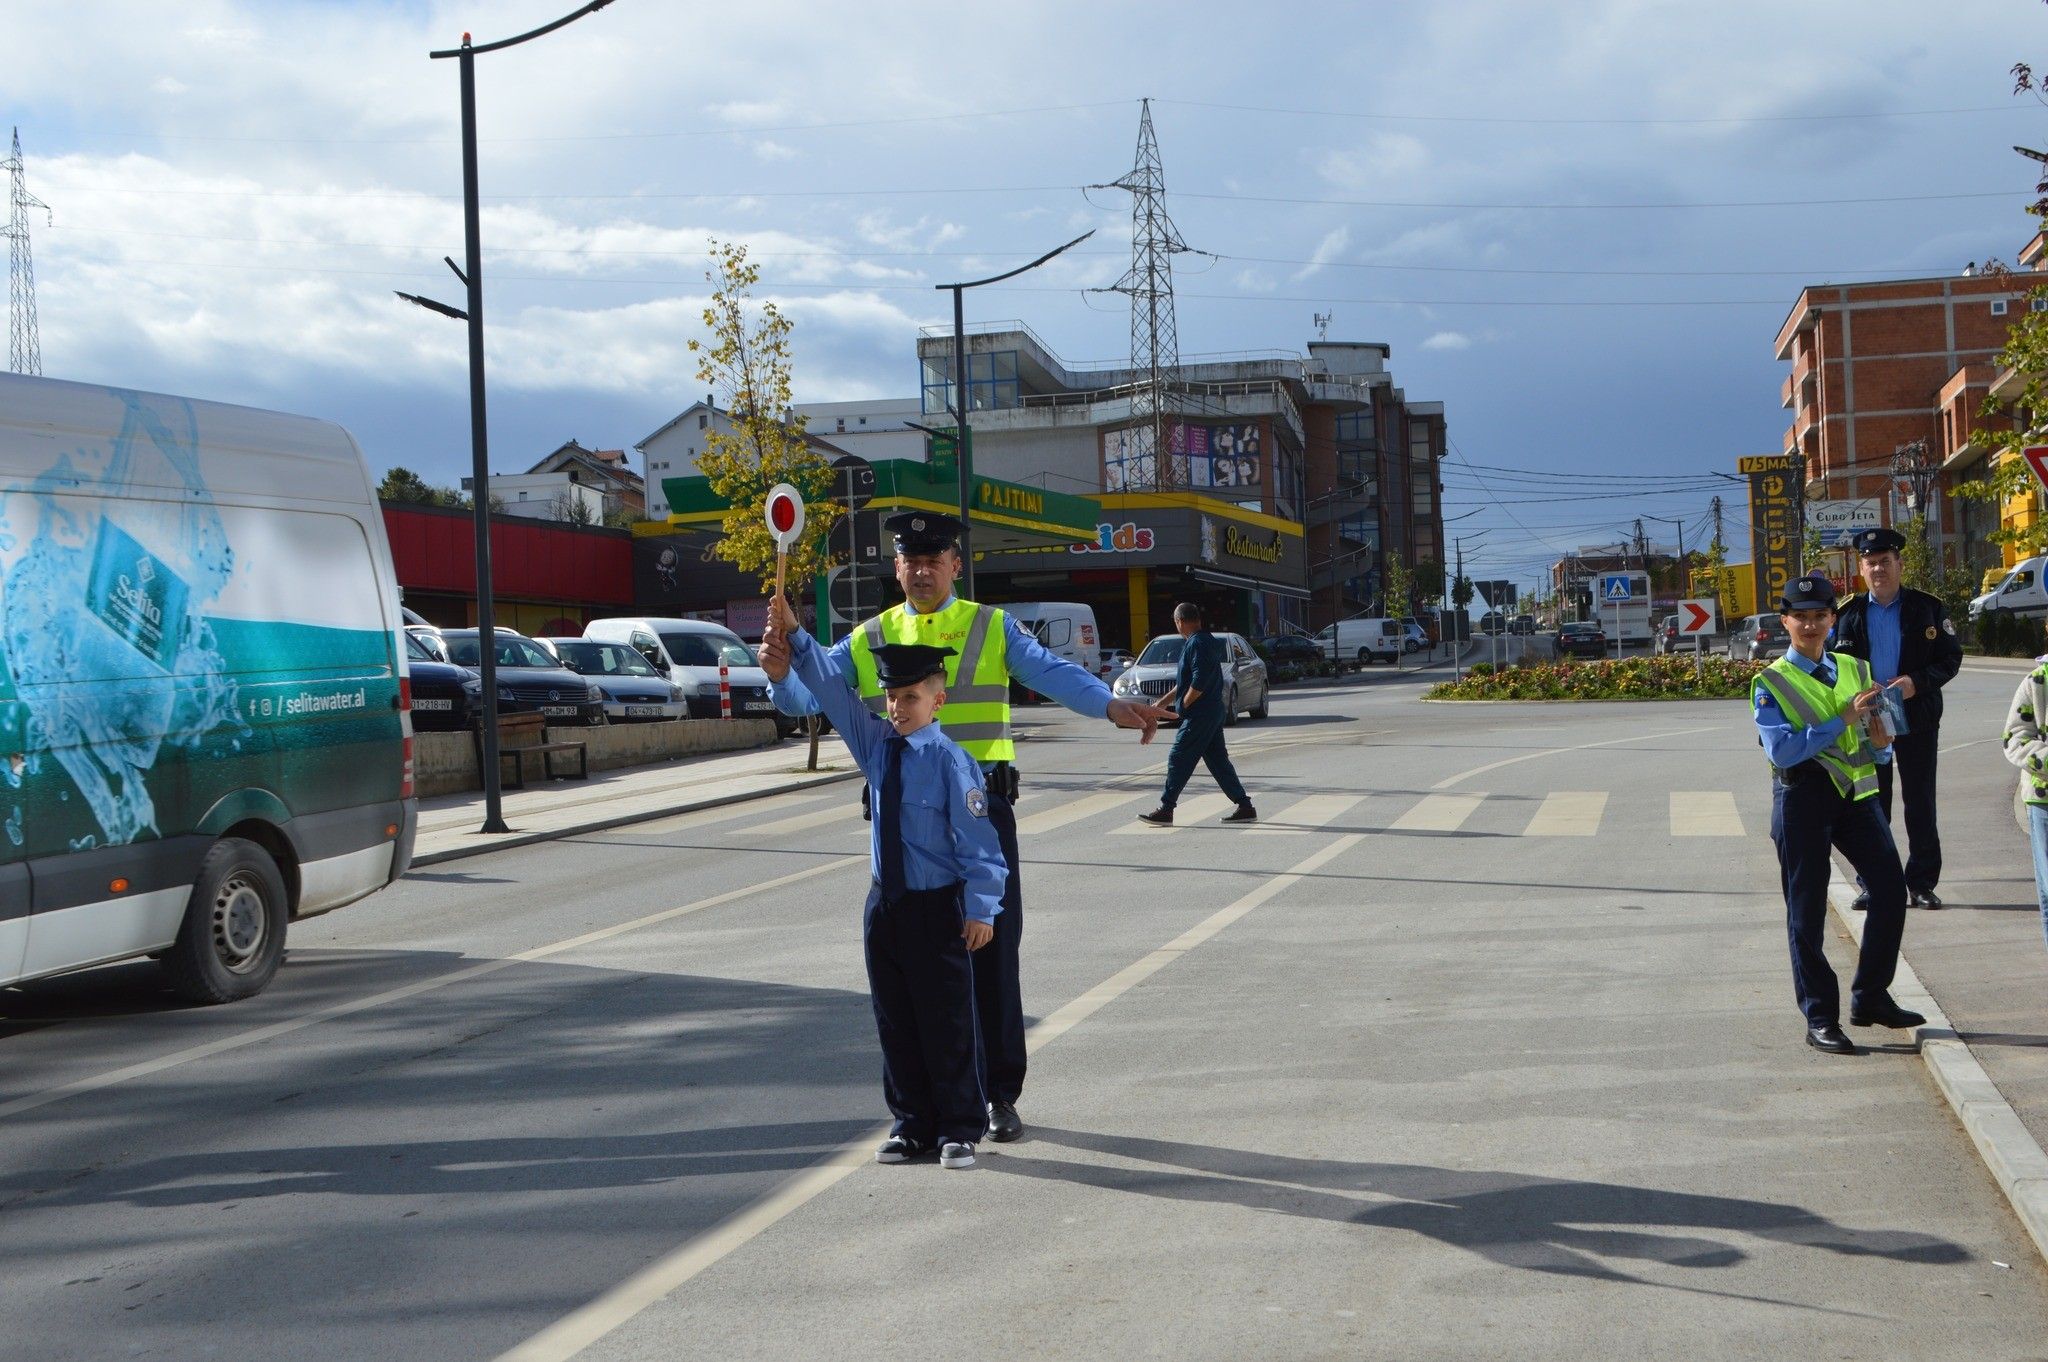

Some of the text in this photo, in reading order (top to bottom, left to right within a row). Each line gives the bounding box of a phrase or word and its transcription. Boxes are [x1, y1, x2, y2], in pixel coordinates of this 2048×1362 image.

[1747, 457, 1764, 471] 75
[1227, 525, 1278, 564] Restaurant
[117, 574, 161, 626] Selita
[1728, 570, 1740, 614] gorenje
[940, 630, 966, 640] POLICE
[286, 688, 365, 714] selitawater.al
